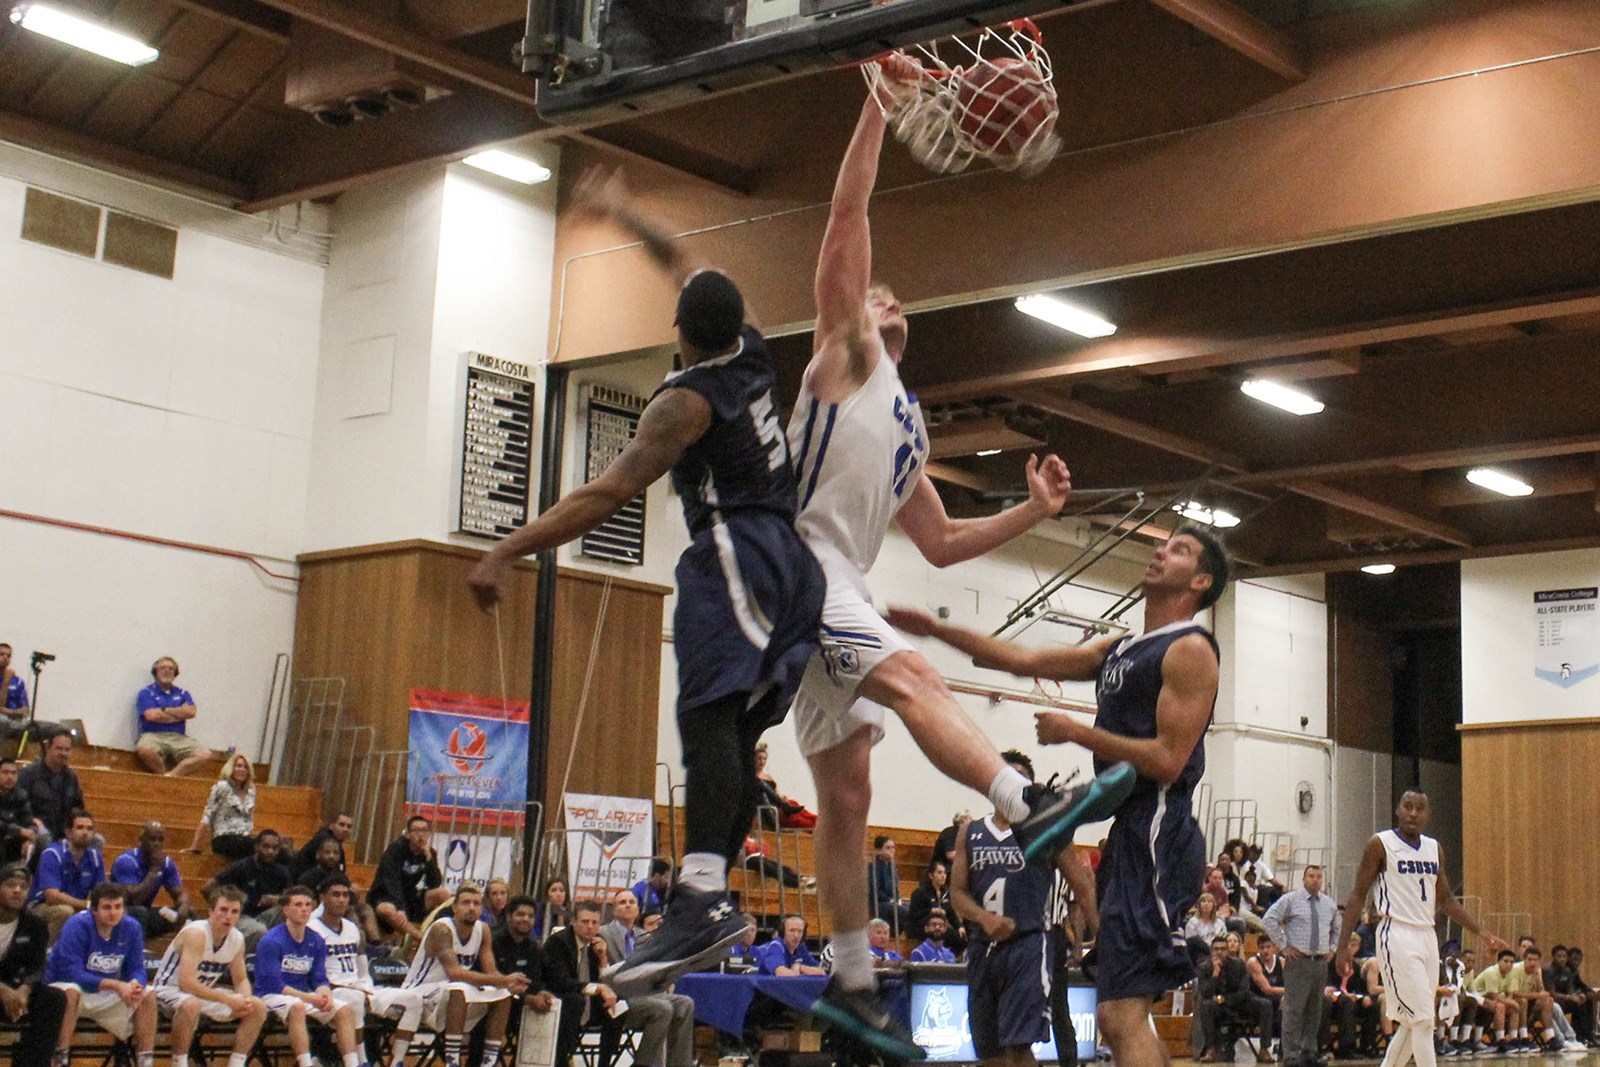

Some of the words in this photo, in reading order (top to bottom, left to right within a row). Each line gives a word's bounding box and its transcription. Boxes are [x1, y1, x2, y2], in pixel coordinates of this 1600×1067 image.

[1537, 606, 1567, 614] ALL-STATE
[1569, 604, 1595, 612] PLAYERS
[568, 806, 649, 824] POLARIZE
[983, 876, 1007, 917] 4
[1419, 878, 1427, 901] 1
